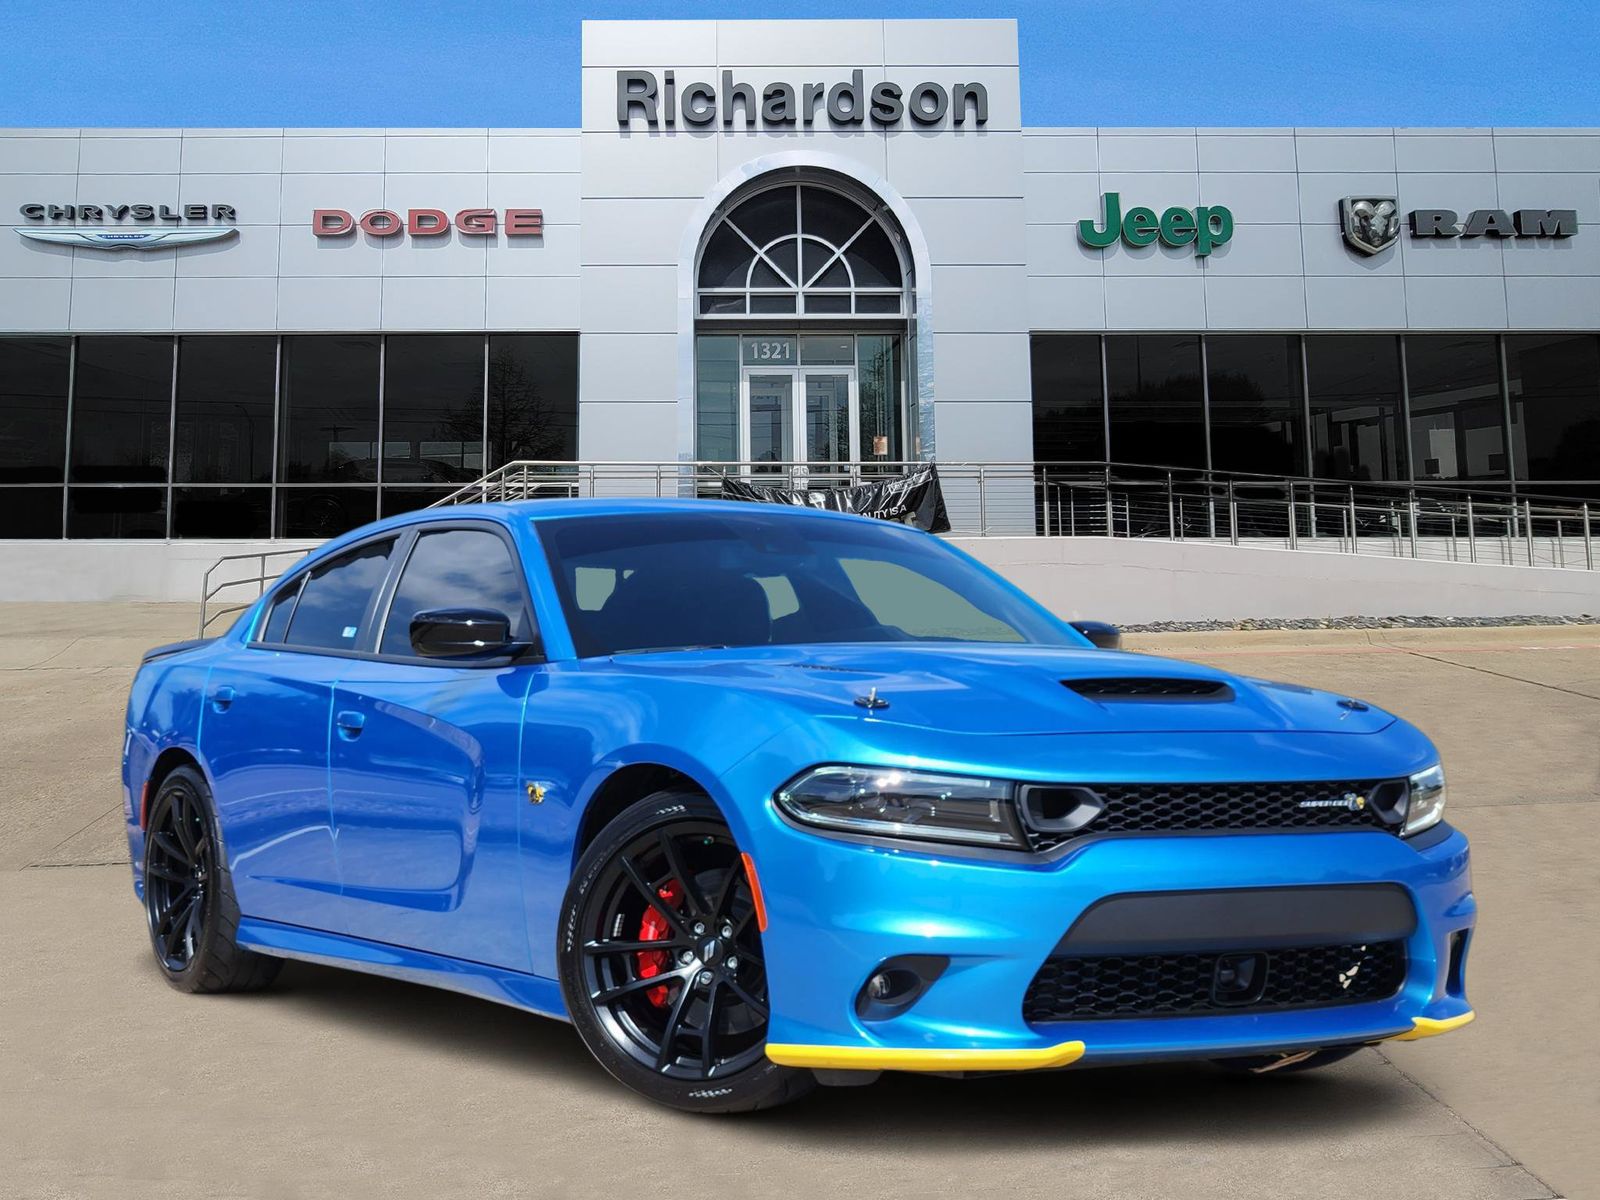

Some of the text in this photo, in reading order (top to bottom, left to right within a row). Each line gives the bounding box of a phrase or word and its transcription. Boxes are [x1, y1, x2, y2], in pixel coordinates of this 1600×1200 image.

[616, 69, 989, 125] Richardson
[19, 203, 237, 222] CHRYSLER
[312, 208, 544, 237] DODGE
[1077, 192, 1235, 258] Jeep
[1409, 209, 1578, 238] RAM
[751, 342, 790, 359] 1321
